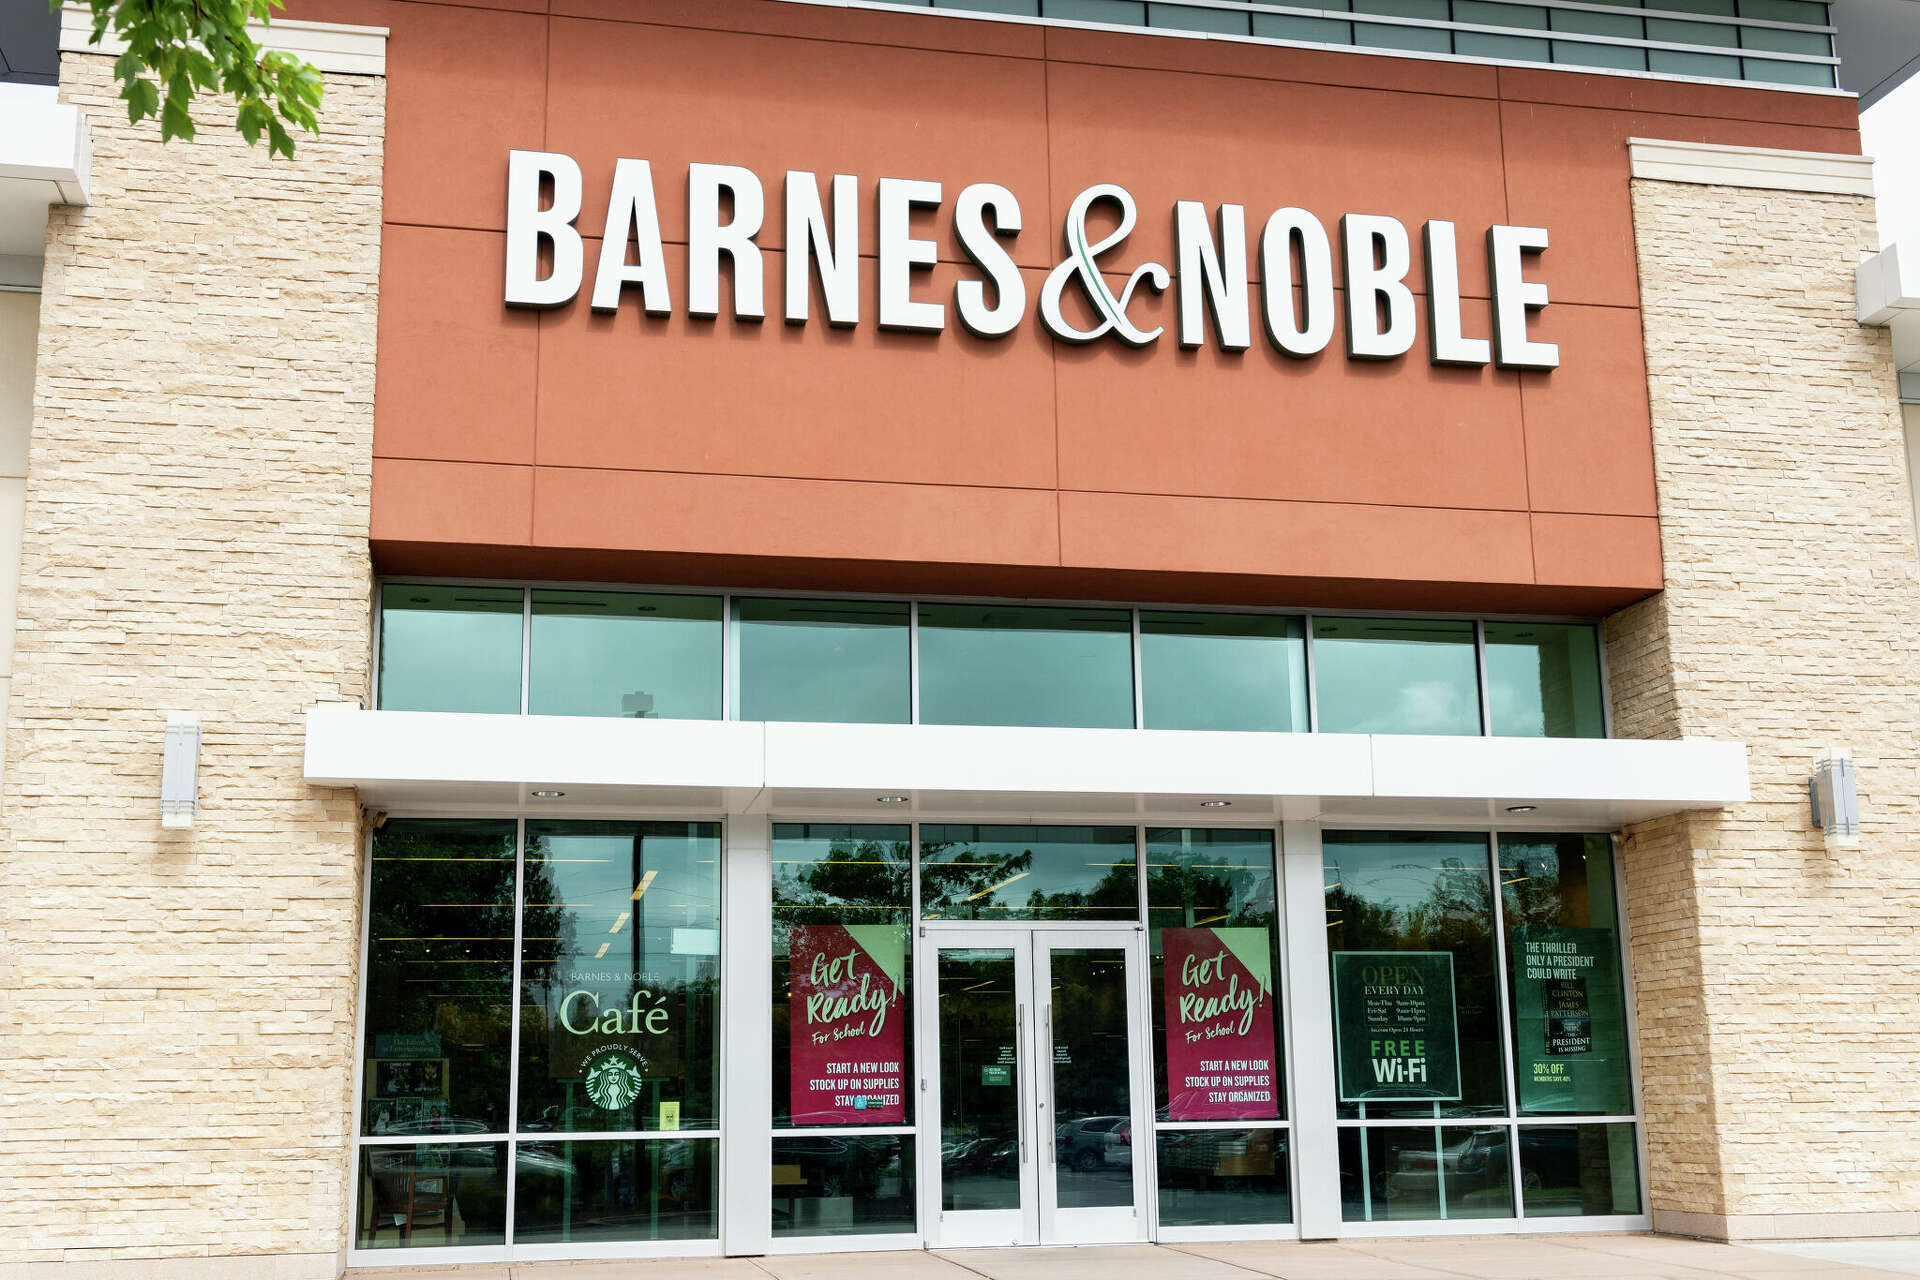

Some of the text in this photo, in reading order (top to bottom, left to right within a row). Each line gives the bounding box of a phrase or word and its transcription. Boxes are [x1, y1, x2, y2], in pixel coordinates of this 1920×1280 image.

[505, 149, 1560, 372] BARNES & NOBLE
[1525, 942, 1577, 954] THE THRILLER
[1526, 955, 1595, 967] ONLY A PRESIDENT
[811, 948, 863, 988] Get
[1182, 950, 1232, 988] Get
[1527, 967, 1577, 980] COULD WRITE
[571, 972, 660, 981] BARNES & NOBLE
[1362, 966, 1424, 985] OPEN
[1365, 986, 1424, 995] EVERY DAY
[807, 973, 899, 1037] Ready!
[1179, 973, 1266, 1036] Ready!
[560, 989, 670, 1035] Café
[811, 1021, 866, 1046] For School
[1185, 1020, 1236, 1044] For School
[1552, 1037, 1590, 1046] PRESIDENT
[581, 1043, 649, 1067] WE PROUDLY SERVE
[1370, 1040, 1426, 1057] FREE
[826, 1062, 900, 1074] START A NEW LOOK
[1200, 1060, 1269, 1071] START A NEW LOOK
[1371, 1057, 1427, 1083] Wi-Fi
[1533, 1063, 1564, 1074] 30% OFF
[809, 1078, 900, 1091] STOCK UP ON SUPPLIES
[1185, 1075, 1270, 1087] STOCK UP ON SUPPLIES
[834, 1095, 855, 1107] STAY
[1208, 1091, 1271, 1103] STAY ORGANIZED
